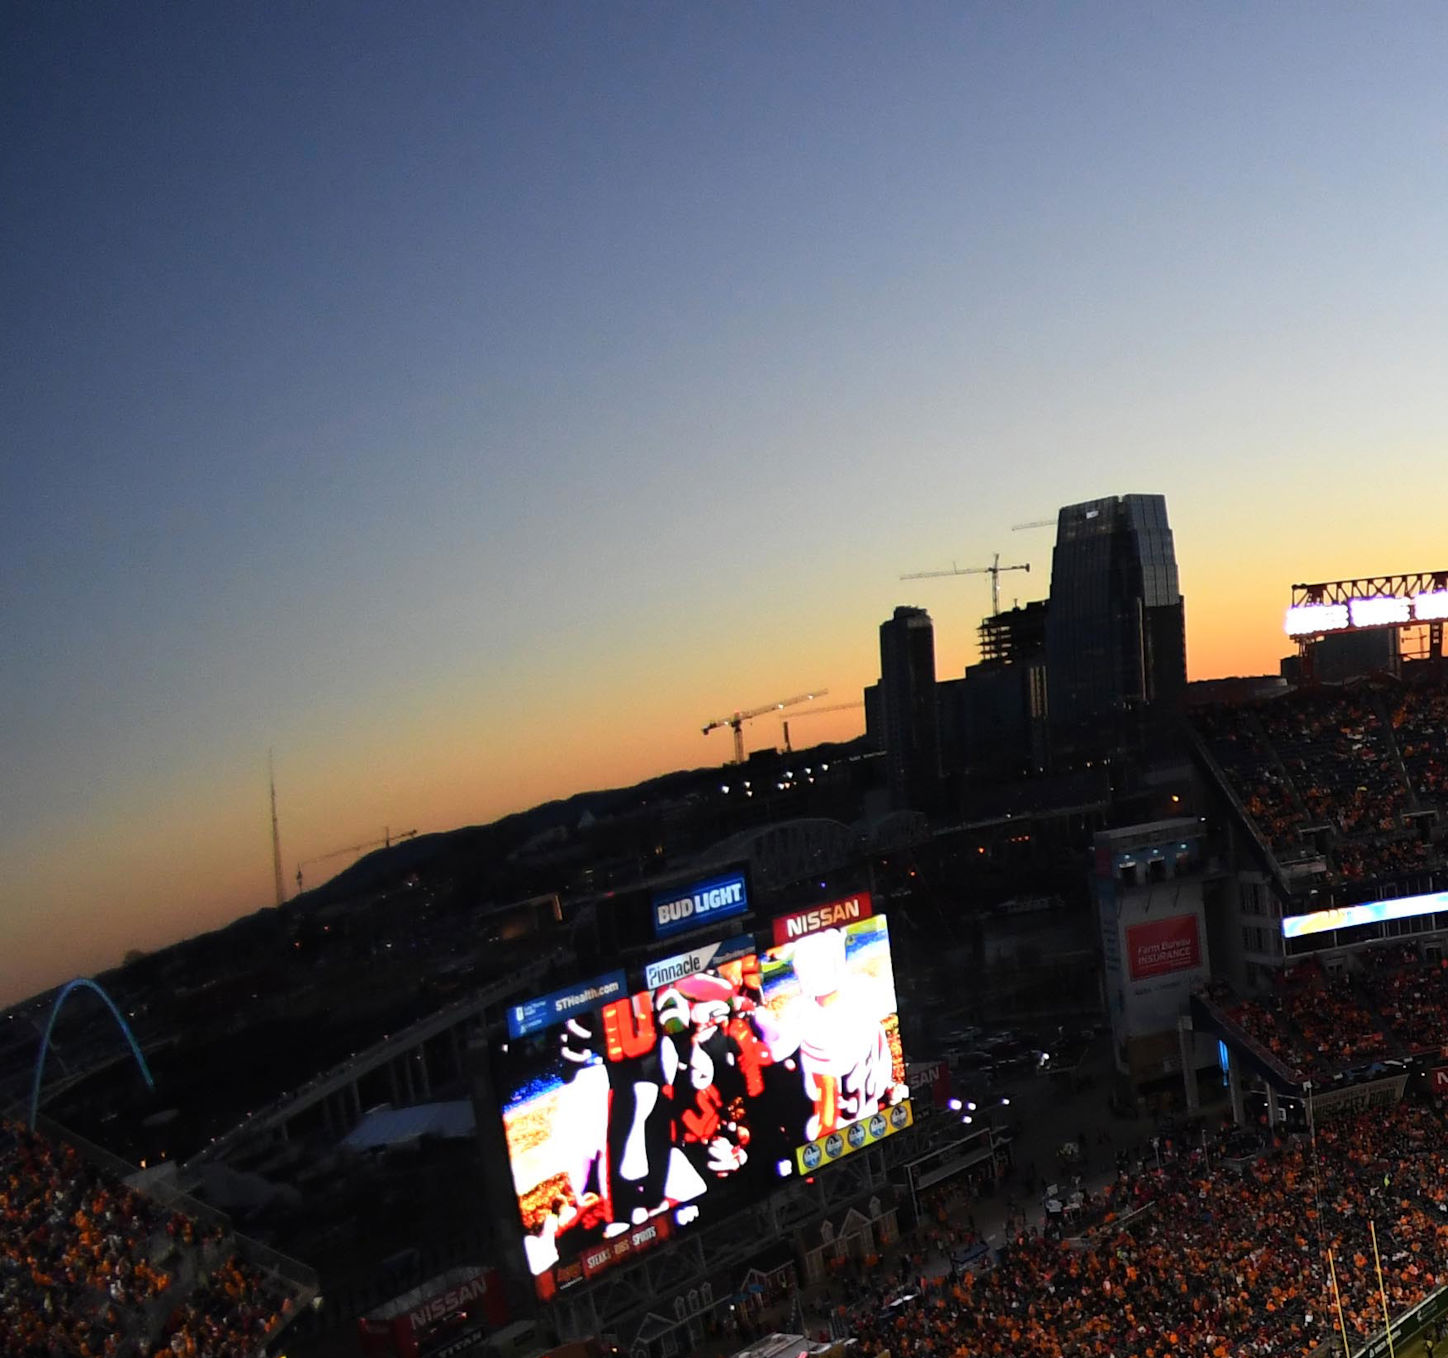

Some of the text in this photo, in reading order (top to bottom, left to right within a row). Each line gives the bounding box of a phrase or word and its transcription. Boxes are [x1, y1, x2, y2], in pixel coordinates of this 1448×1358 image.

[657, 883, 742, 925] BUD LIGHT
[787, 899, 860, 938] NISSAN
[649, 954, 700, 988] Pinnacle
[1137, 947, 1191, 965] INSURANCE
[555, 981, 619, 1012] STHealth.com
[410, 1277, 488, 1329] NISSAN
